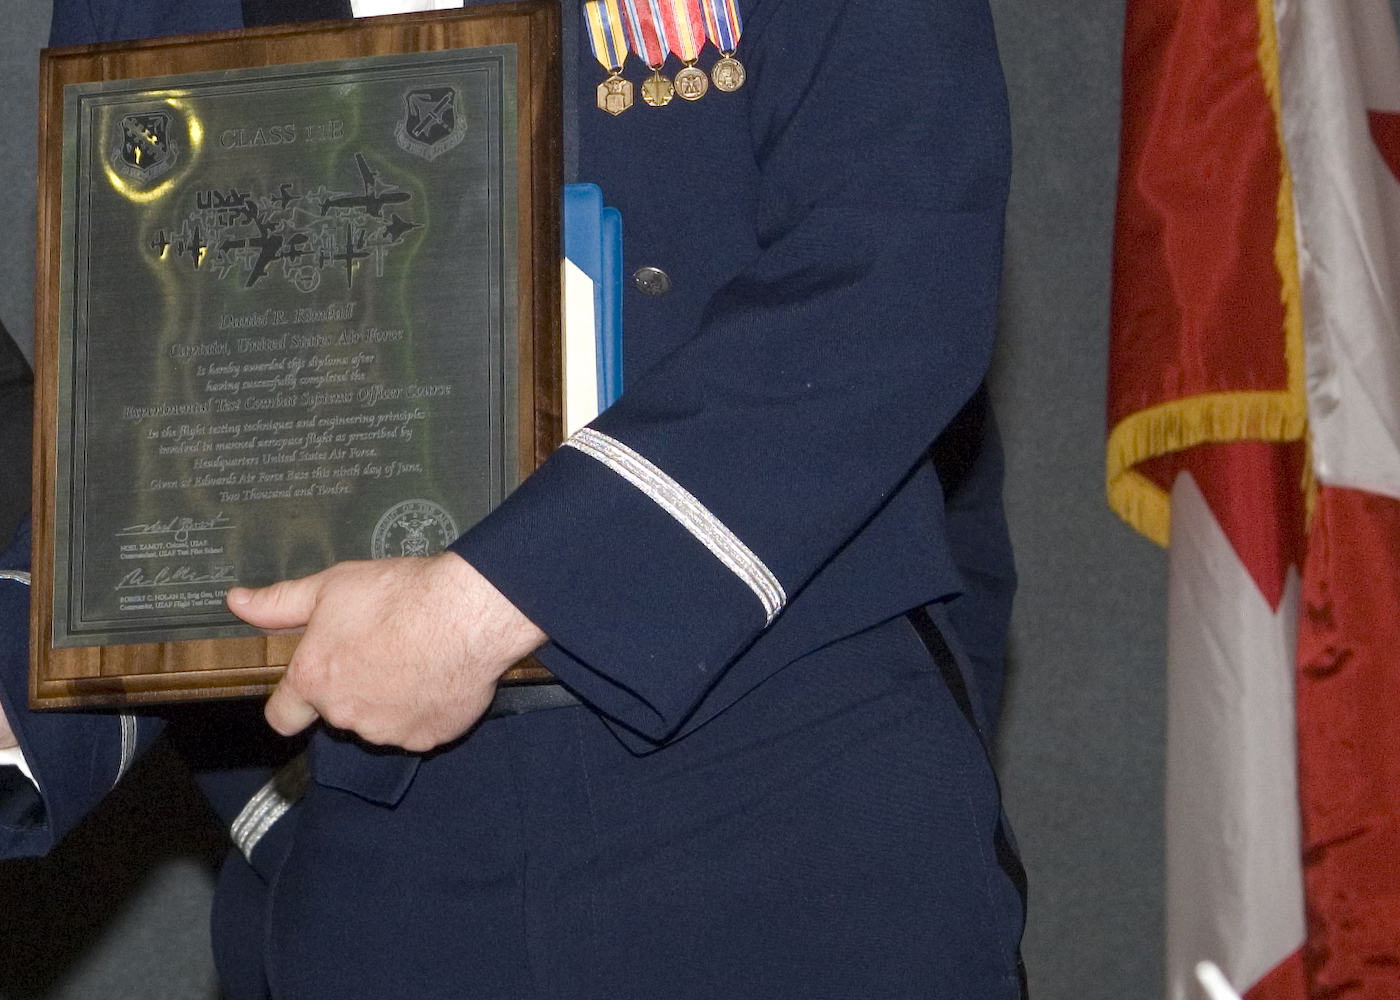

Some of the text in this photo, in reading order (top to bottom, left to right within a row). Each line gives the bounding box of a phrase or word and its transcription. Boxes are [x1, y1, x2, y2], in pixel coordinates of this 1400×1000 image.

[220, 120, 344, 149] CLASS 11B
[219, 302, 356, 329] Daniel R. Kimball
[170, 328, 403, 363] Captain, United States Air Force
[208, 362, 240, 377] hereby
[243, 358, 285, 372] awarded
[287, 356, 305, 369] this
[308, 356, 348, 371] diploma
[351, 352, 375, 368] after
[206, 369, 365, 394] having successfully completed the
[122, 384, 451, 424] Experimental Test Combat Systems Officer Course
[147, 408, 425, 441] In the flight testing techniques and engineering principles
[159, 425, 413, 455] involved in manned aerospace flight as prescribed by
[193, 448, 377, 471] Headquarters United States Air Force.
[150, 461, 422, 490] Given at Edwards Air Force Base this ninth day of June,
[220, 482, 351, 502] Two Thousand and Twelve.
[403, 503, 414, 511] OF
[419, 504, 436, 512] THE
[437, 513, 450, 527] AIR
[120, 595, 146, 603] ROBERT
[174, 600, 190, 608] Flight
